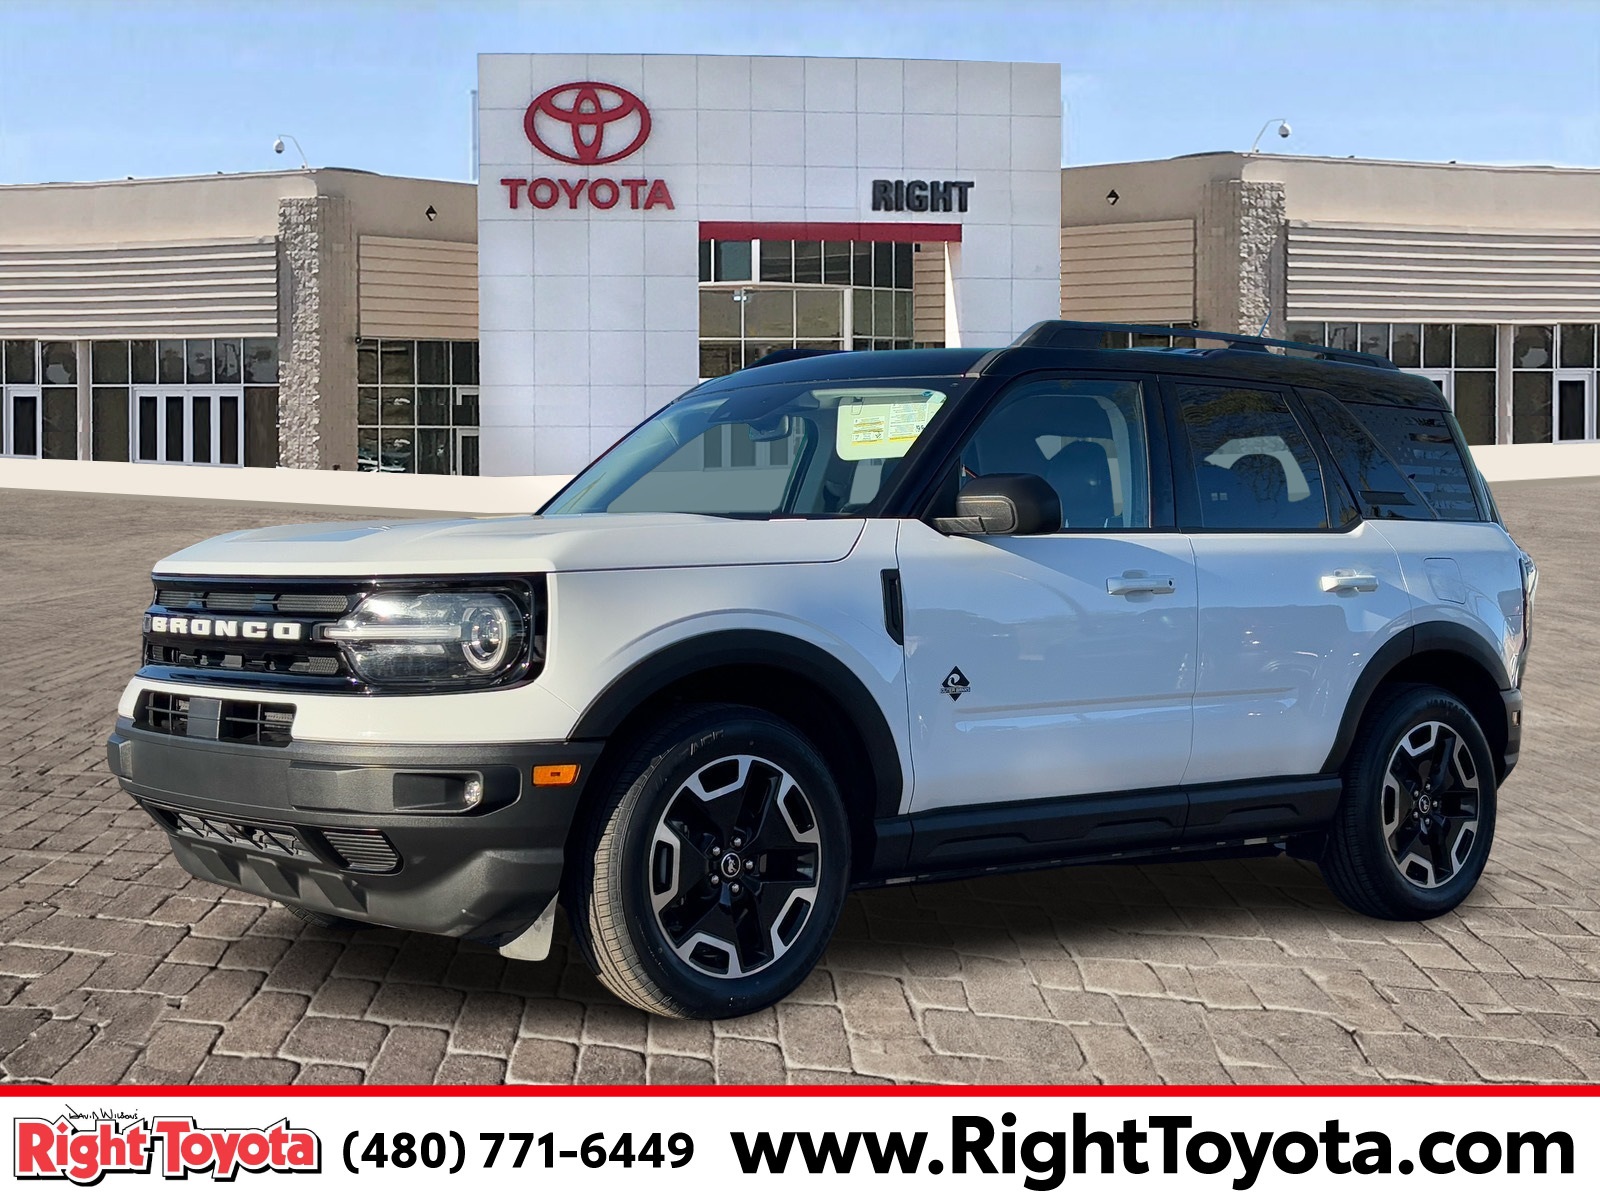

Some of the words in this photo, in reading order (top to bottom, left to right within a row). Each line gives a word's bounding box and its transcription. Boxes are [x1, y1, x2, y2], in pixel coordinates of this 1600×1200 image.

[500, 178, 675, 210] TOYOTA
[872, 179, 975, 212] RIGHT
[152, 616, 301, 640] BRONCO
